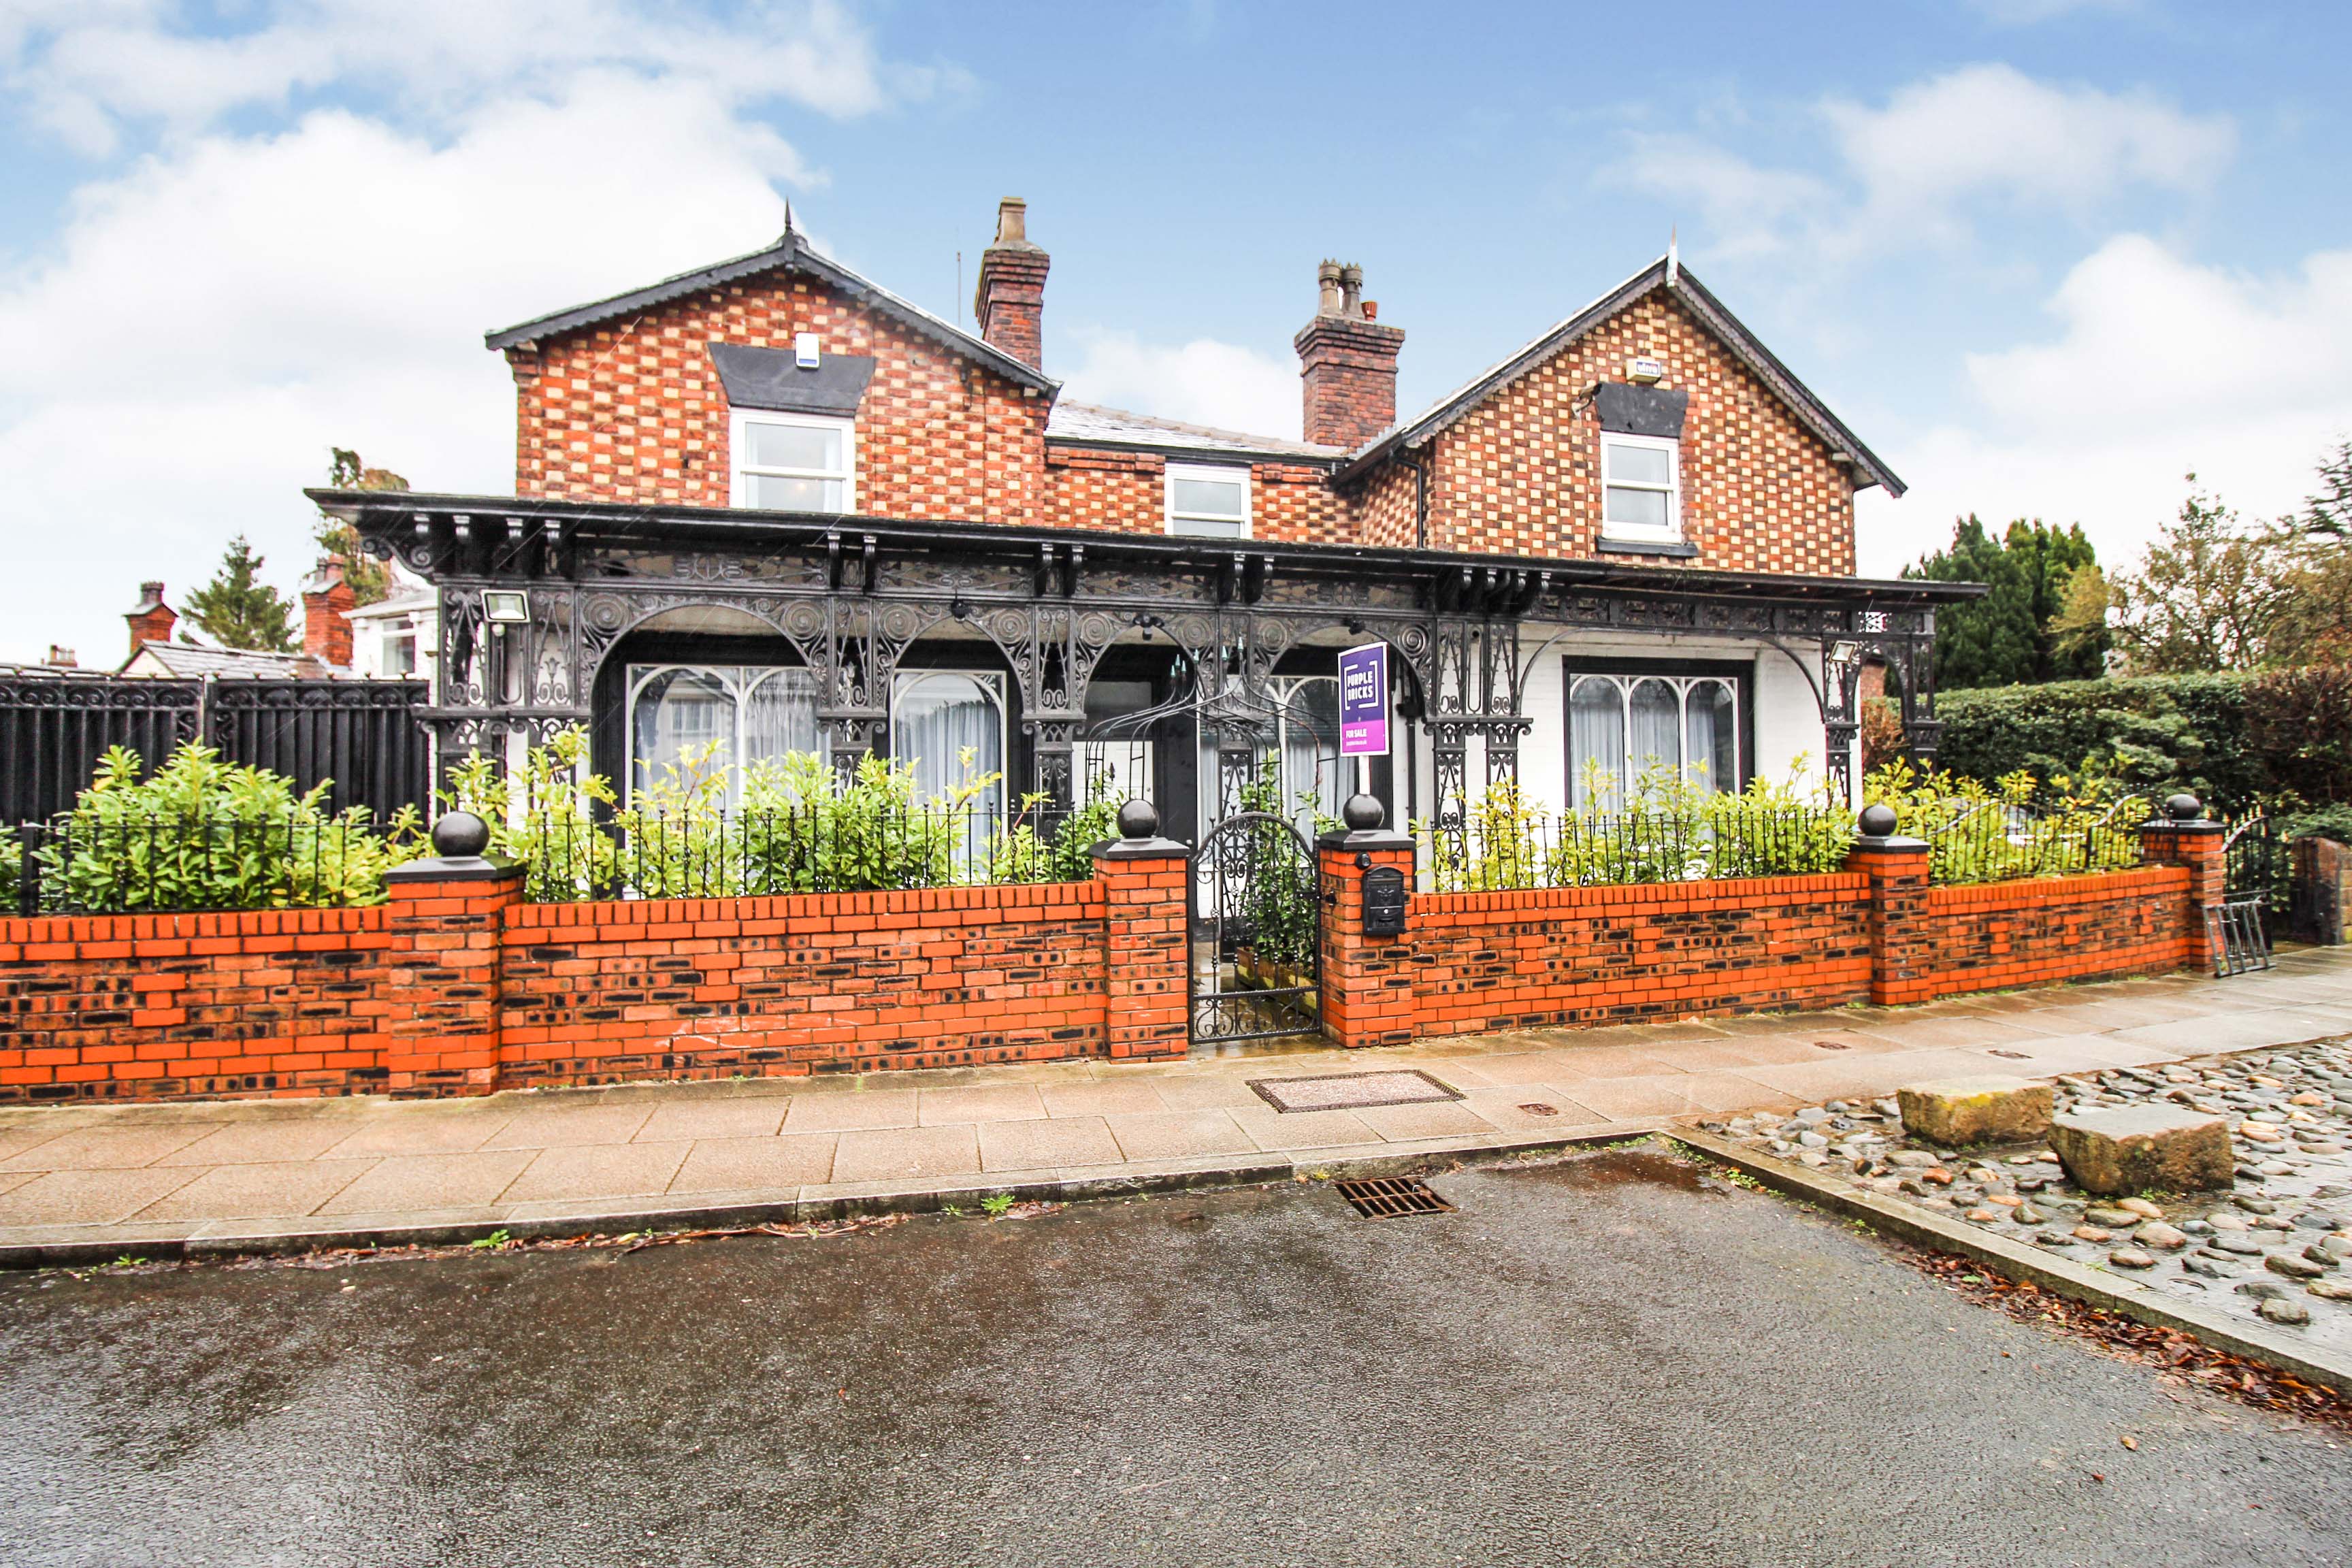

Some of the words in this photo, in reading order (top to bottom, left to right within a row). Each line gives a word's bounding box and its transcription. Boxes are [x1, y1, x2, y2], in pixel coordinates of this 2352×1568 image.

[1347, 671, 1373, 687] PURPLE
[1348, 685, 1373, 701] BRICKS
[1345, 730, 1354, 738] FOR
[1354, 728, 1367, 738] SALE
